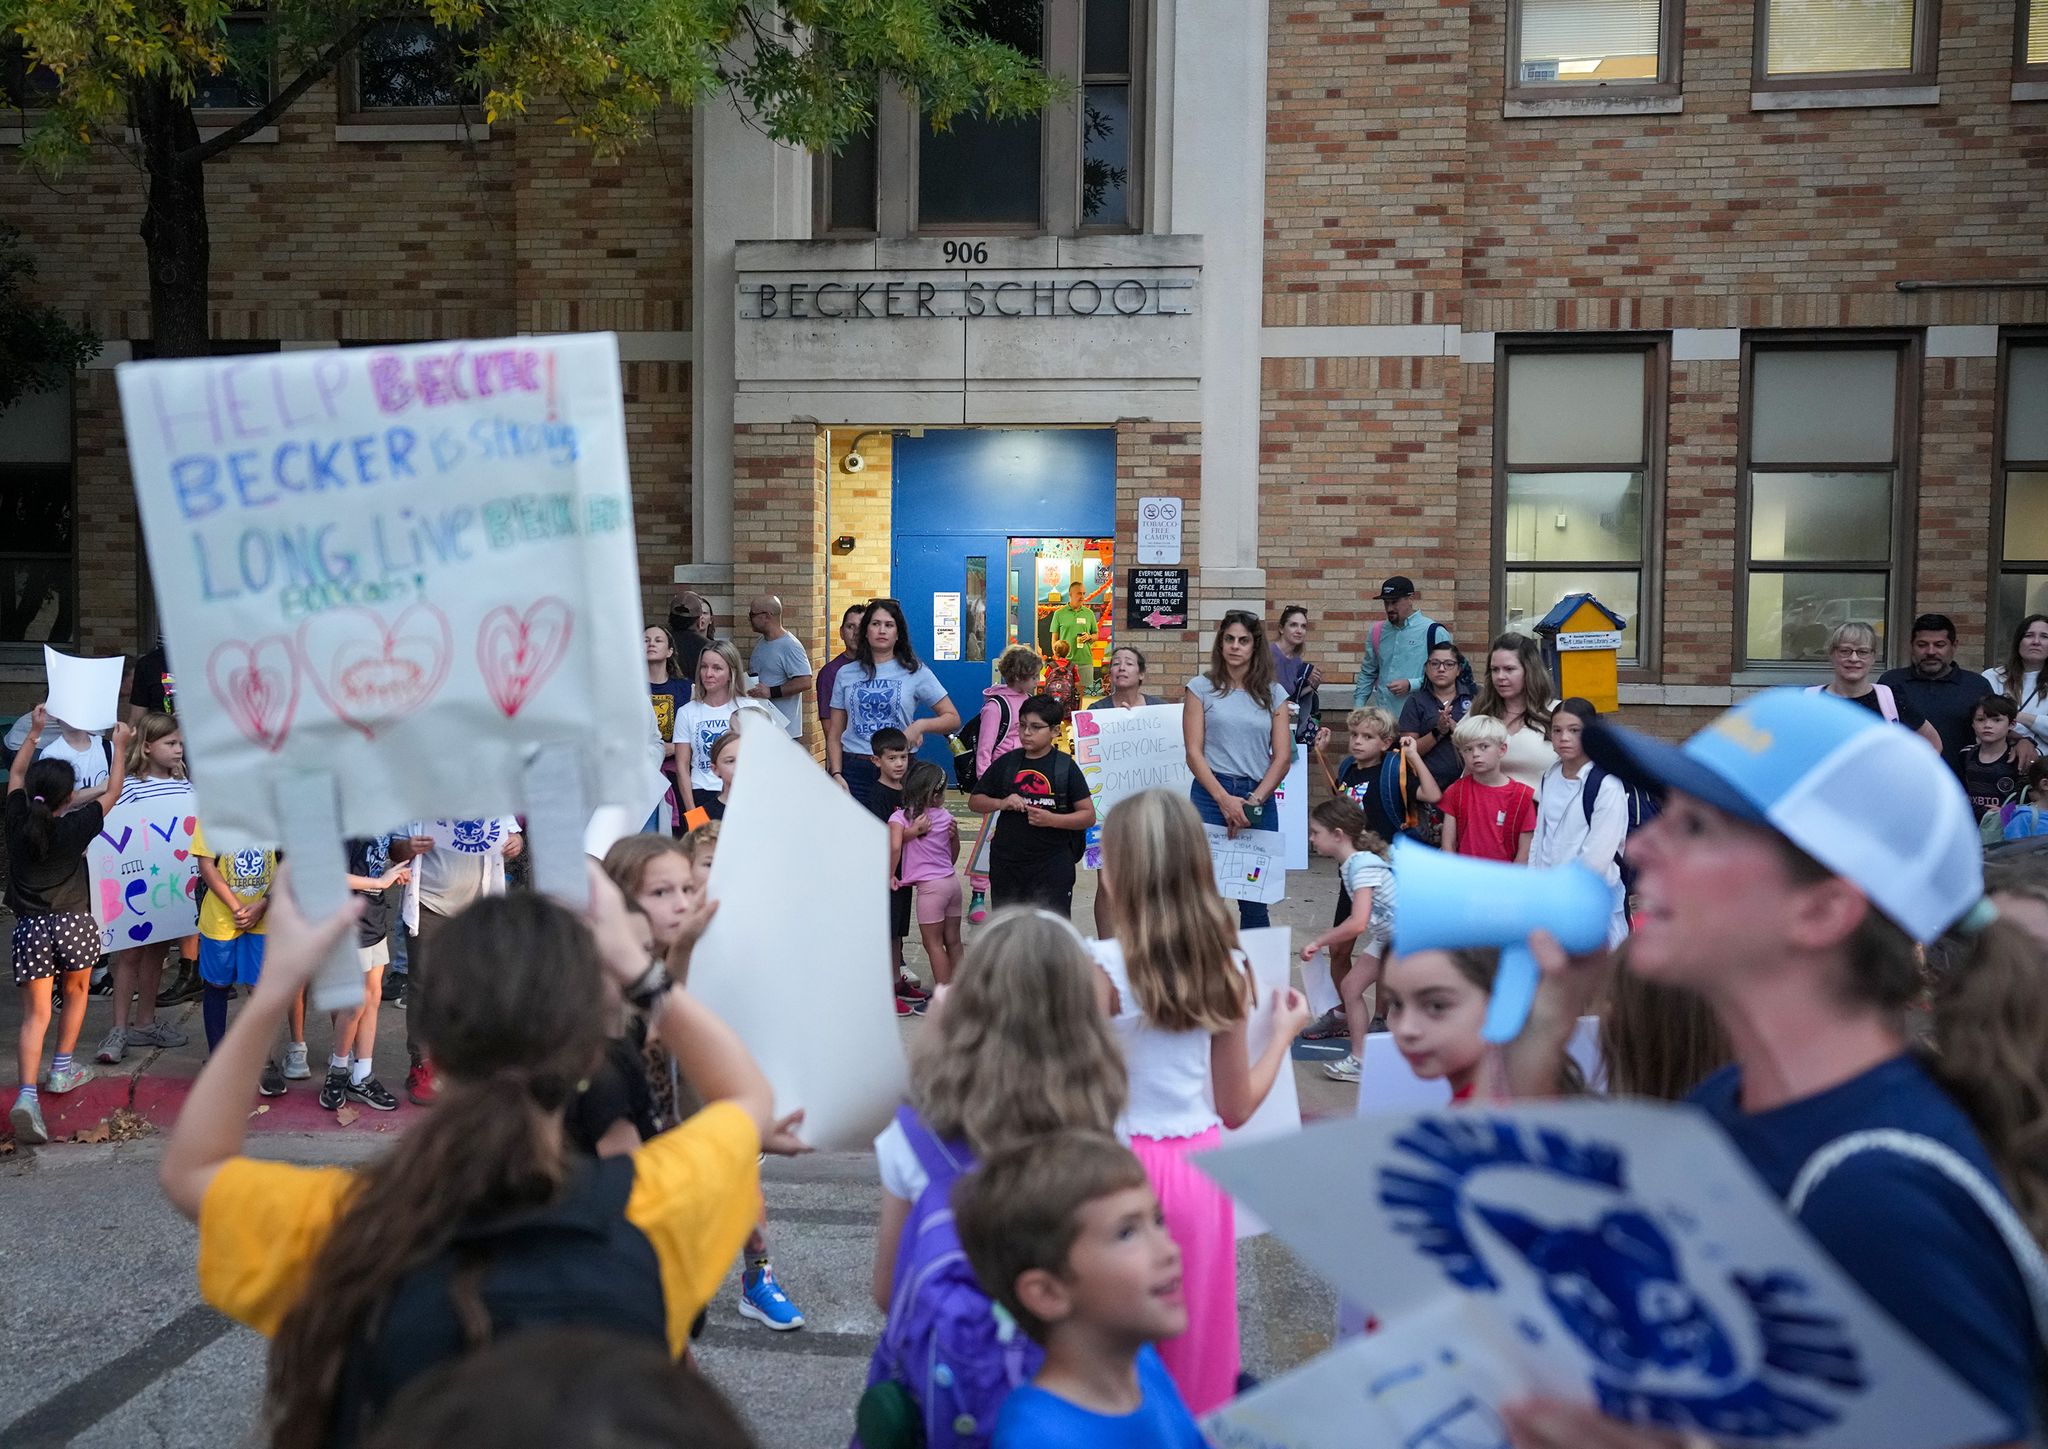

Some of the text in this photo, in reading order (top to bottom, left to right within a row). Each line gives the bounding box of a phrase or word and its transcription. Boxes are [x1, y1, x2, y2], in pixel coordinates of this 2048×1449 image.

[942, 240, 989, 265] 906
[759, 279, 1177, 319] BECKER SCHOOL
[149, 354, 350, 458] HELP
[169, 425, 418, 521] BECKER
[191, 518, 361, 604] LONG
[865, 680, 889, 689] VIVA
[705, 720, 727, 728] VIVA
[1075, 712, 1161, 738] BRINGING
[1083, 762, 1187, 795] COMMUNITY
